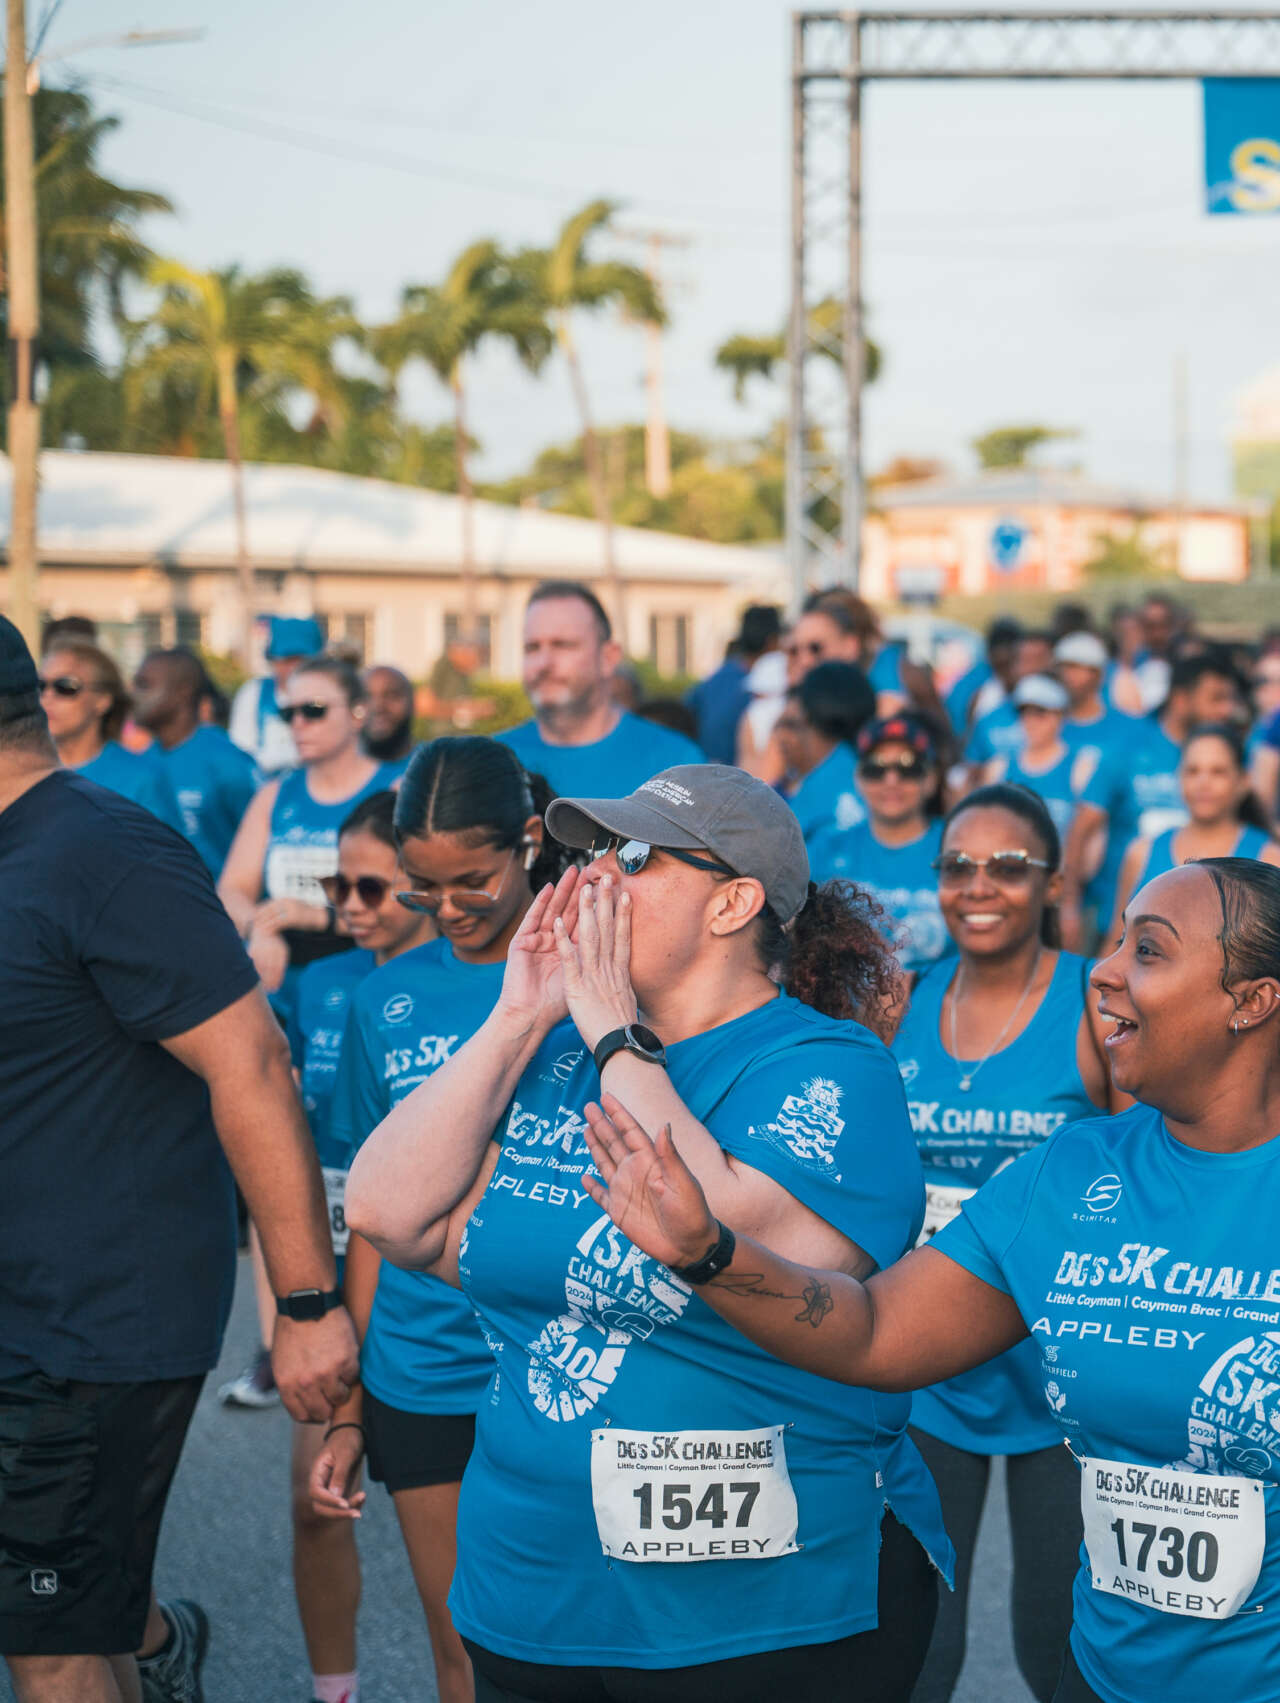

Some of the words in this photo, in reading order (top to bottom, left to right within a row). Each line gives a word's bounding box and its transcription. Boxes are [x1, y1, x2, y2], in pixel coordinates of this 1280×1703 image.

[490, 1172, 590, 1209] PLEBY
[593, 1224, 651, 1288] 5K
[1108, 1243, 1170, 1290] 5K
[567, 1256, 678, 1326] CHALLENGE
[567, 1286, 593, 1302] 2024
[1046, 1291, 1075, 1304] Little
[1077, 1294, 1121, 1308] Cayman
[1131, 1297, 1187, 1316] Cayman
[1190, 1303, 1221, 1318] Brac
[1233, 1307, 1278, 1325] Grand
[1031, 1316, 1207, 1350] APPLEBY
[547, 1334, 597, 1380] 10
[1217, 1360, 1280, 1422] 5K
[651, 1436, 679, 1460] 5K
[682, 1439, 773, 1460] CHALLENGE
[1190, 1426, 1216, 1440] 2024
[617, 1462, 635, 1470] Little
[636, 1463, 663, 1471] Cayman
[669, 1464, 699, 1472] Cayman
[700, 1463, 717, 1471] Brac
[633, 1482, 761, 1530] 1547
[1096, 1493, 1110, 1503] Little
[1110, 1496, 1134, 1507] Cayman
[1138, 1501, 1163, 1511] Cayman
[1164, 1505, 1179, 1514] Brac
[1183, 1508, 1205, 1517] Grand
[1206, 1511, 1239, 1521] Cayman
[1124, 1468, 1150, 1497] 5K
[1151, 1479, 1240, 1509] CHALLENGE
[622, 1538, 771, 1556] APPLEBY
[1111, 1518, 1219, 1583] 1730
[1112, 1576, 1227, 1613] APPLEBY
